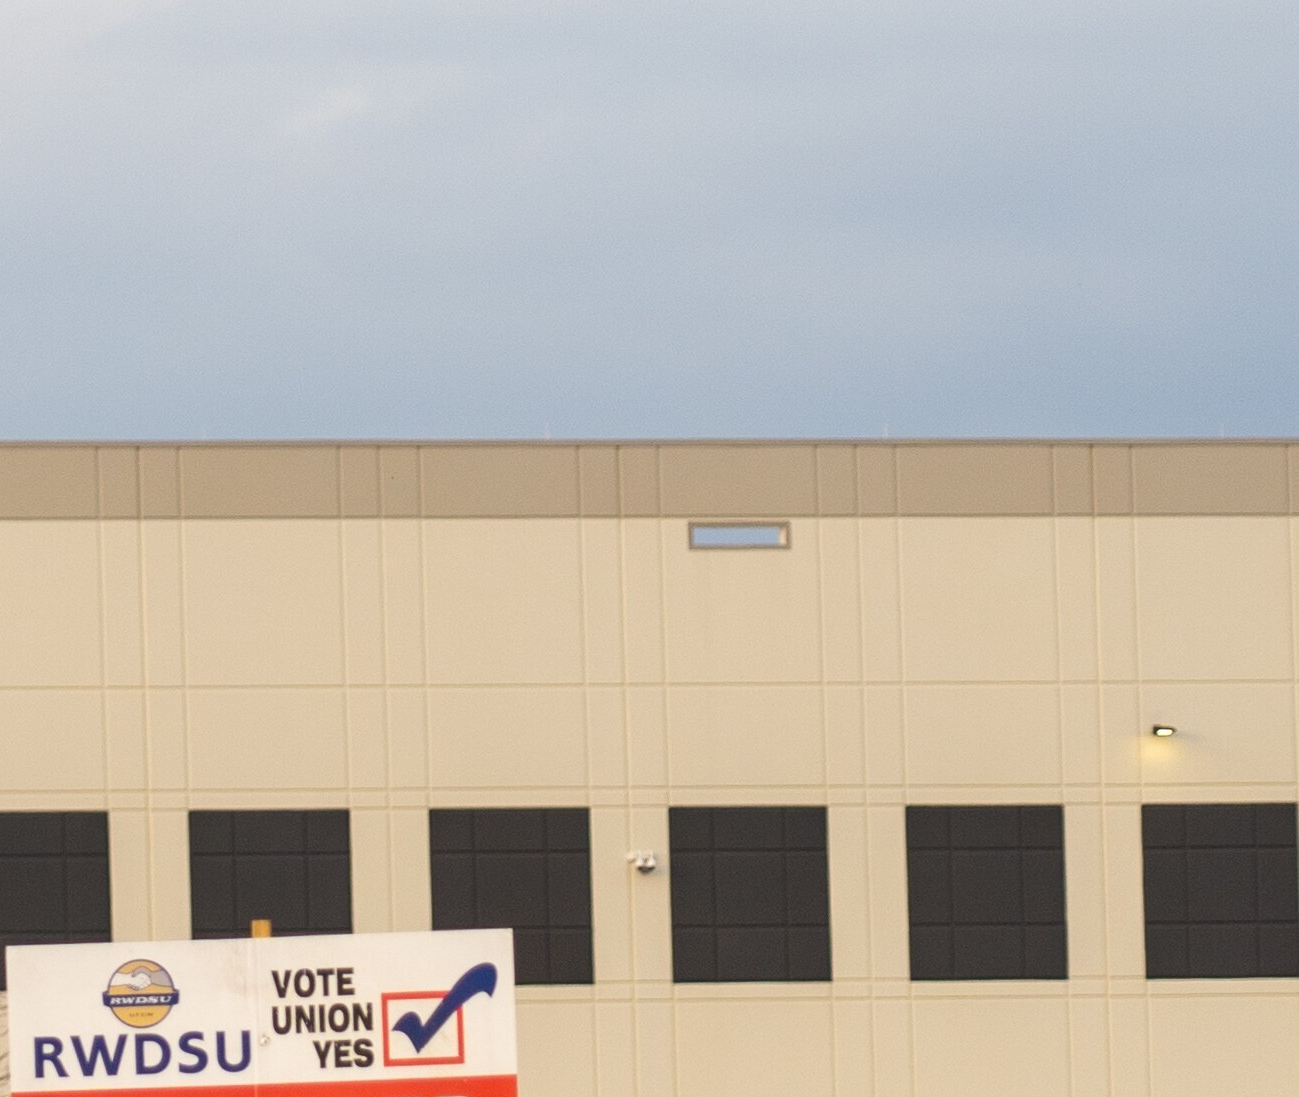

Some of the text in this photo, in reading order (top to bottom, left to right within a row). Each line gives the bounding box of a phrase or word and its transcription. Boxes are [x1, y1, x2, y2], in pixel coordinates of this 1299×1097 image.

[271, 967, 355, 998] VOTE
[110, 995, 172, 1005] RWDSU
[271, 1002, 374, 1034] UNION
[34, 1030, 252, 1078] RWDSU
[313, 1038, 375, 1069] YES
